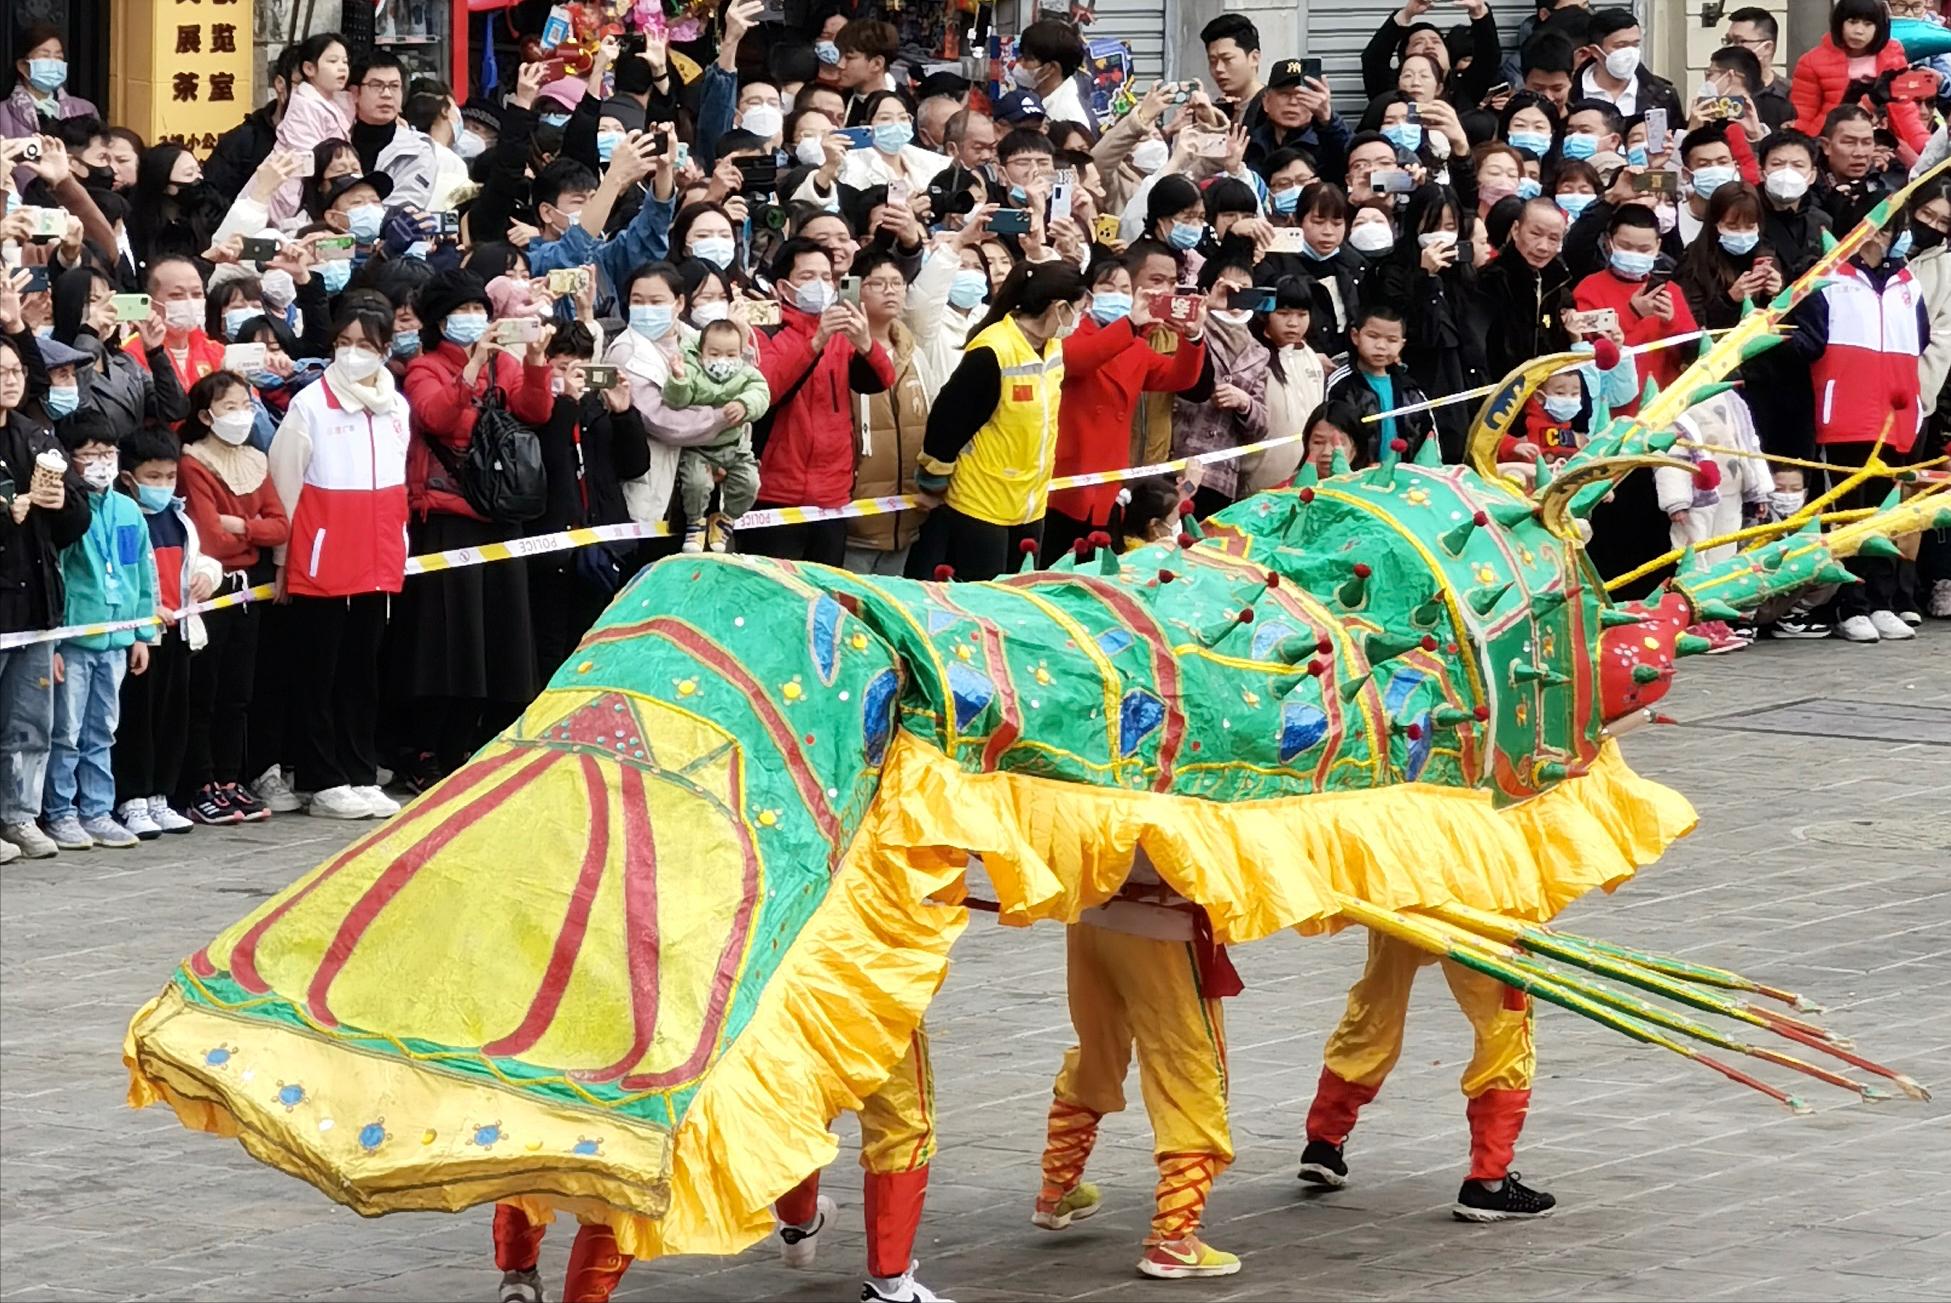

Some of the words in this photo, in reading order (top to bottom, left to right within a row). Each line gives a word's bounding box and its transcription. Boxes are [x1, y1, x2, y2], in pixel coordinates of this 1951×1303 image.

[175, 23, 236, 54] 展览
[172, 72, 235, 102] 茶室
[518, 537, 557, 553] POLICE
